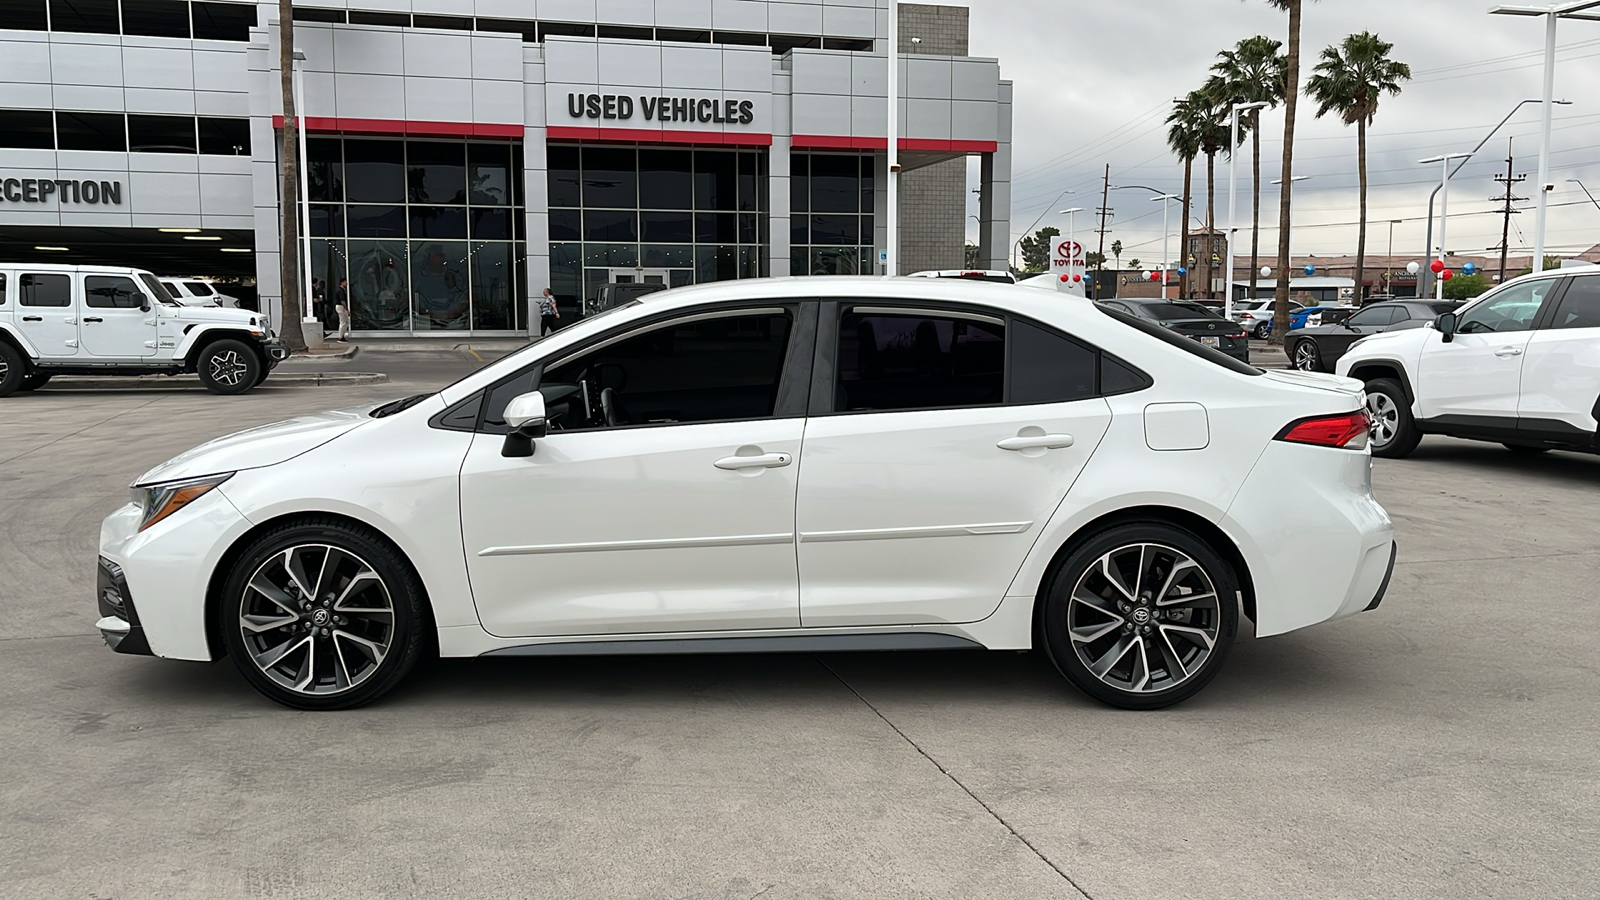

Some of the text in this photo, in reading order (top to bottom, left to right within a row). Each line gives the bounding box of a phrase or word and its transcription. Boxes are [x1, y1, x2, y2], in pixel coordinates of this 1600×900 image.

[568, 93, 754, 124] USED VEHICLES
[0, 177, 121, 204] CEPTION
